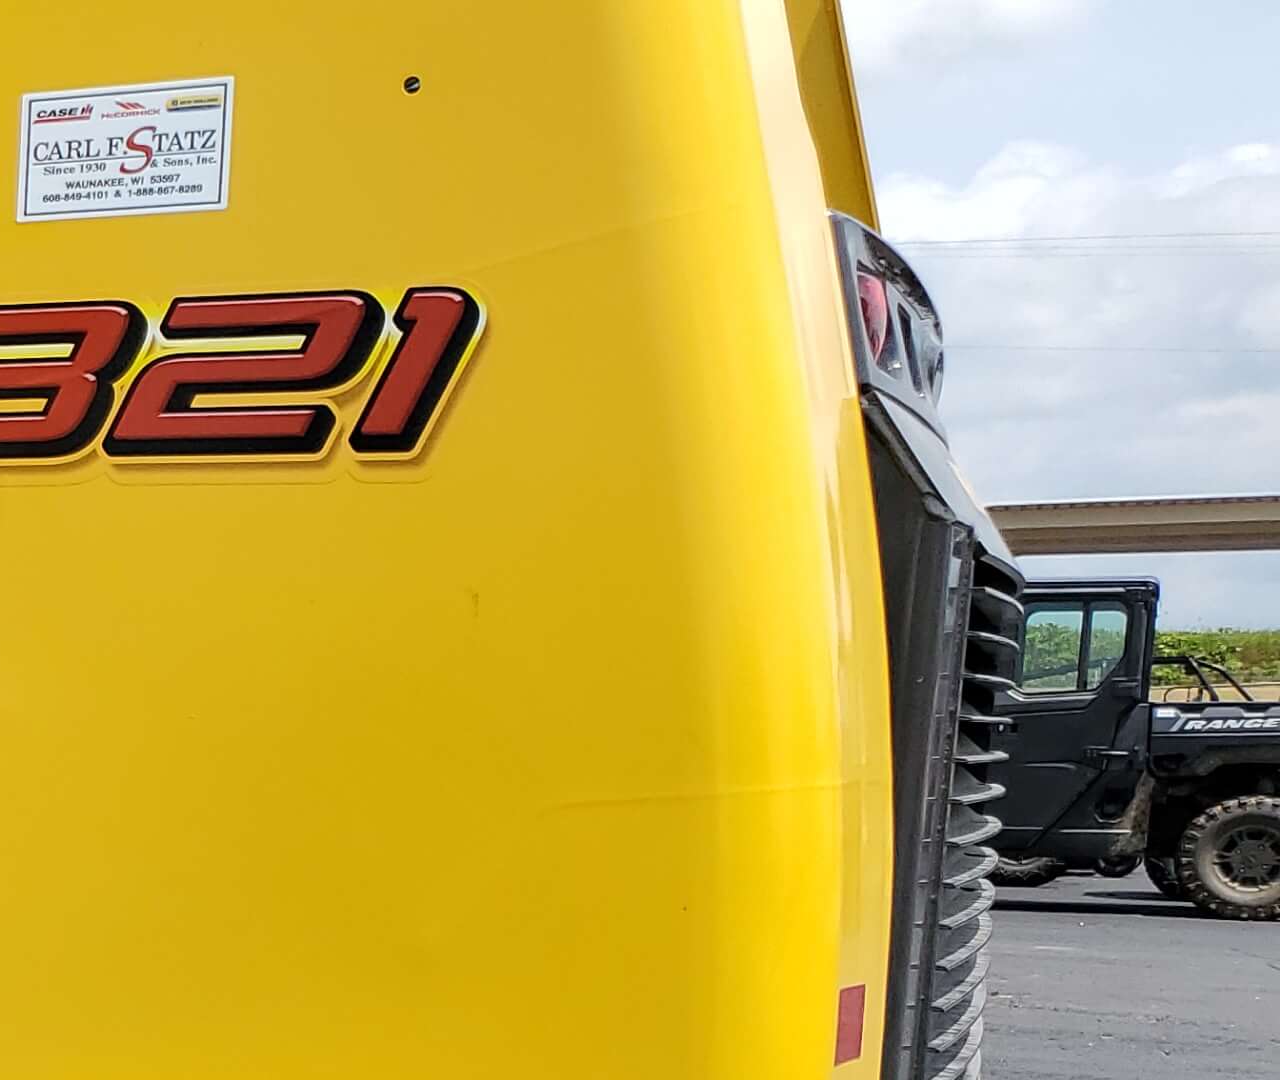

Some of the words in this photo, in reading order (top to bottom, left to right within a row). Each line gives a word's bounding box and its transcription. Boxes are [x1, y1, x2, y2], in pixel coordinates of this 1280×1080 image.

[36, 107, 79, 119] CASE
[33, 138, 100, 161] CARL
[149, 158, 159, 168] &
[162, 157, 193, 168] Sons,
[196, 154, 217, 165] Inc.
[43, 165, 76, 176] Since
[79, 162, 107, 174] 1930
[65, 178, 128, 190] WAUNAKEE,
[130, 176, 145, 186] WI
[149, 173, 181, 184] 53597
[113, 189, 122, 198] &
